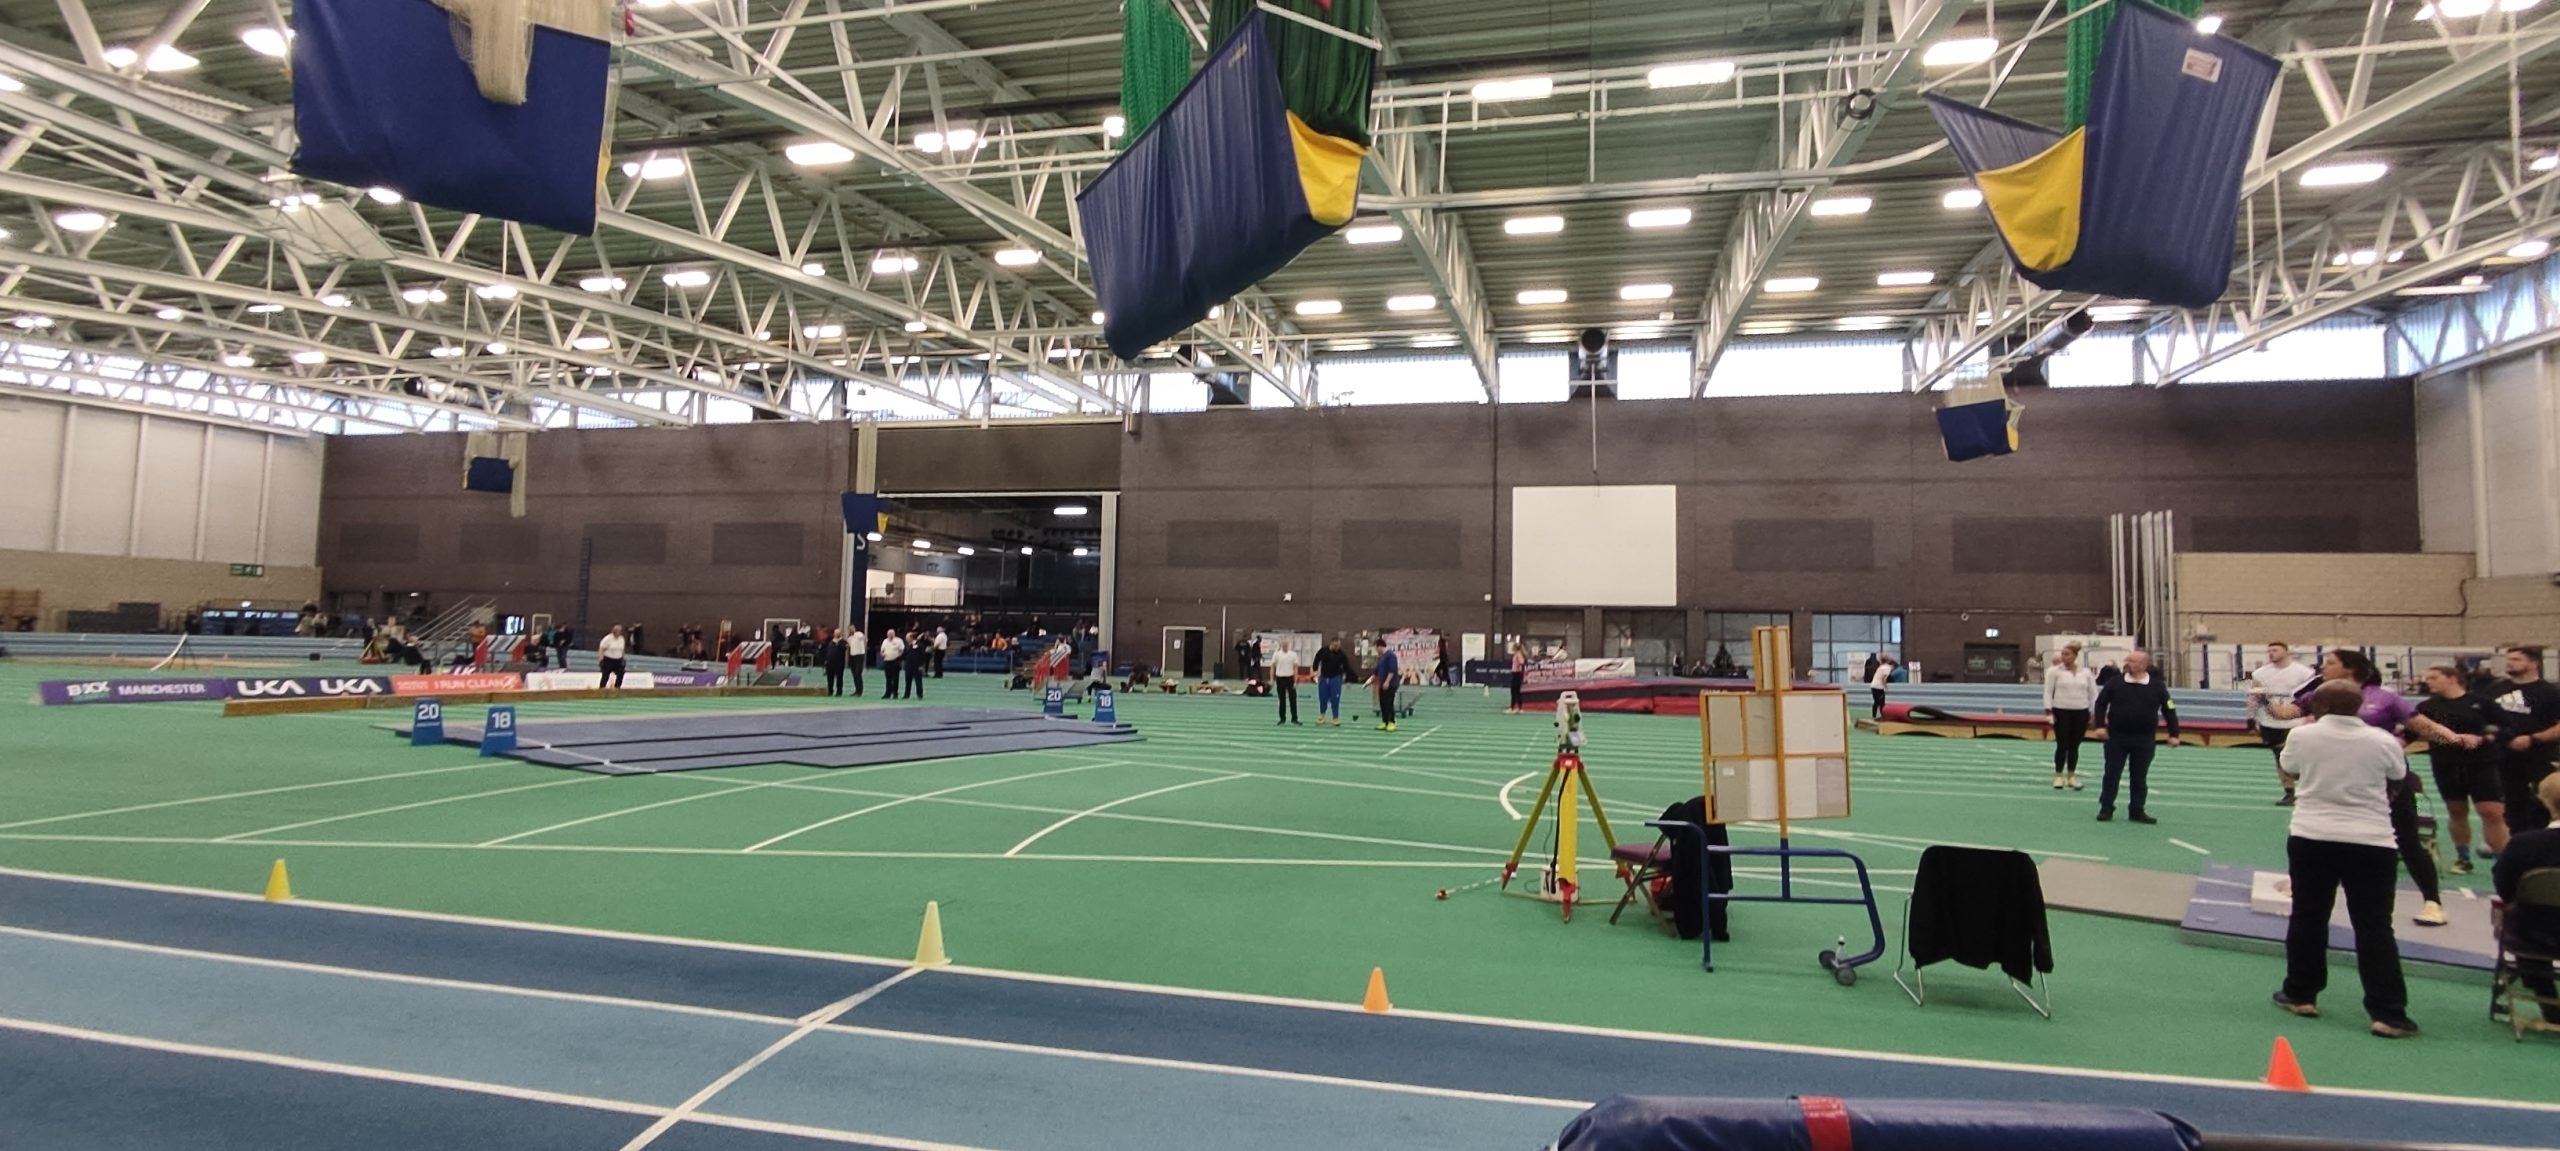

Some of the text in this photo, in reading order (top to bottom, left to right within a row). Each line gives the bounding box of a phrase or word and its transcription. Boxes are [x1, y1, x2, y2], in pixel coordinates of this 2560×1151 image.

[117, 683, 206, 697] MANCHESTER
[236, 679, 306, 696] UKA
[319, 678, 383, 695] UKA
[440, 679, 466, 690] RUN
[466, 678, 502, 689] CLEAN
[1047, 690, 1062, 702] 20
[1098, 695, 1112, 708] 18
[417, 703, 440, 720] 20
[491, 711, 512, 729] 18
